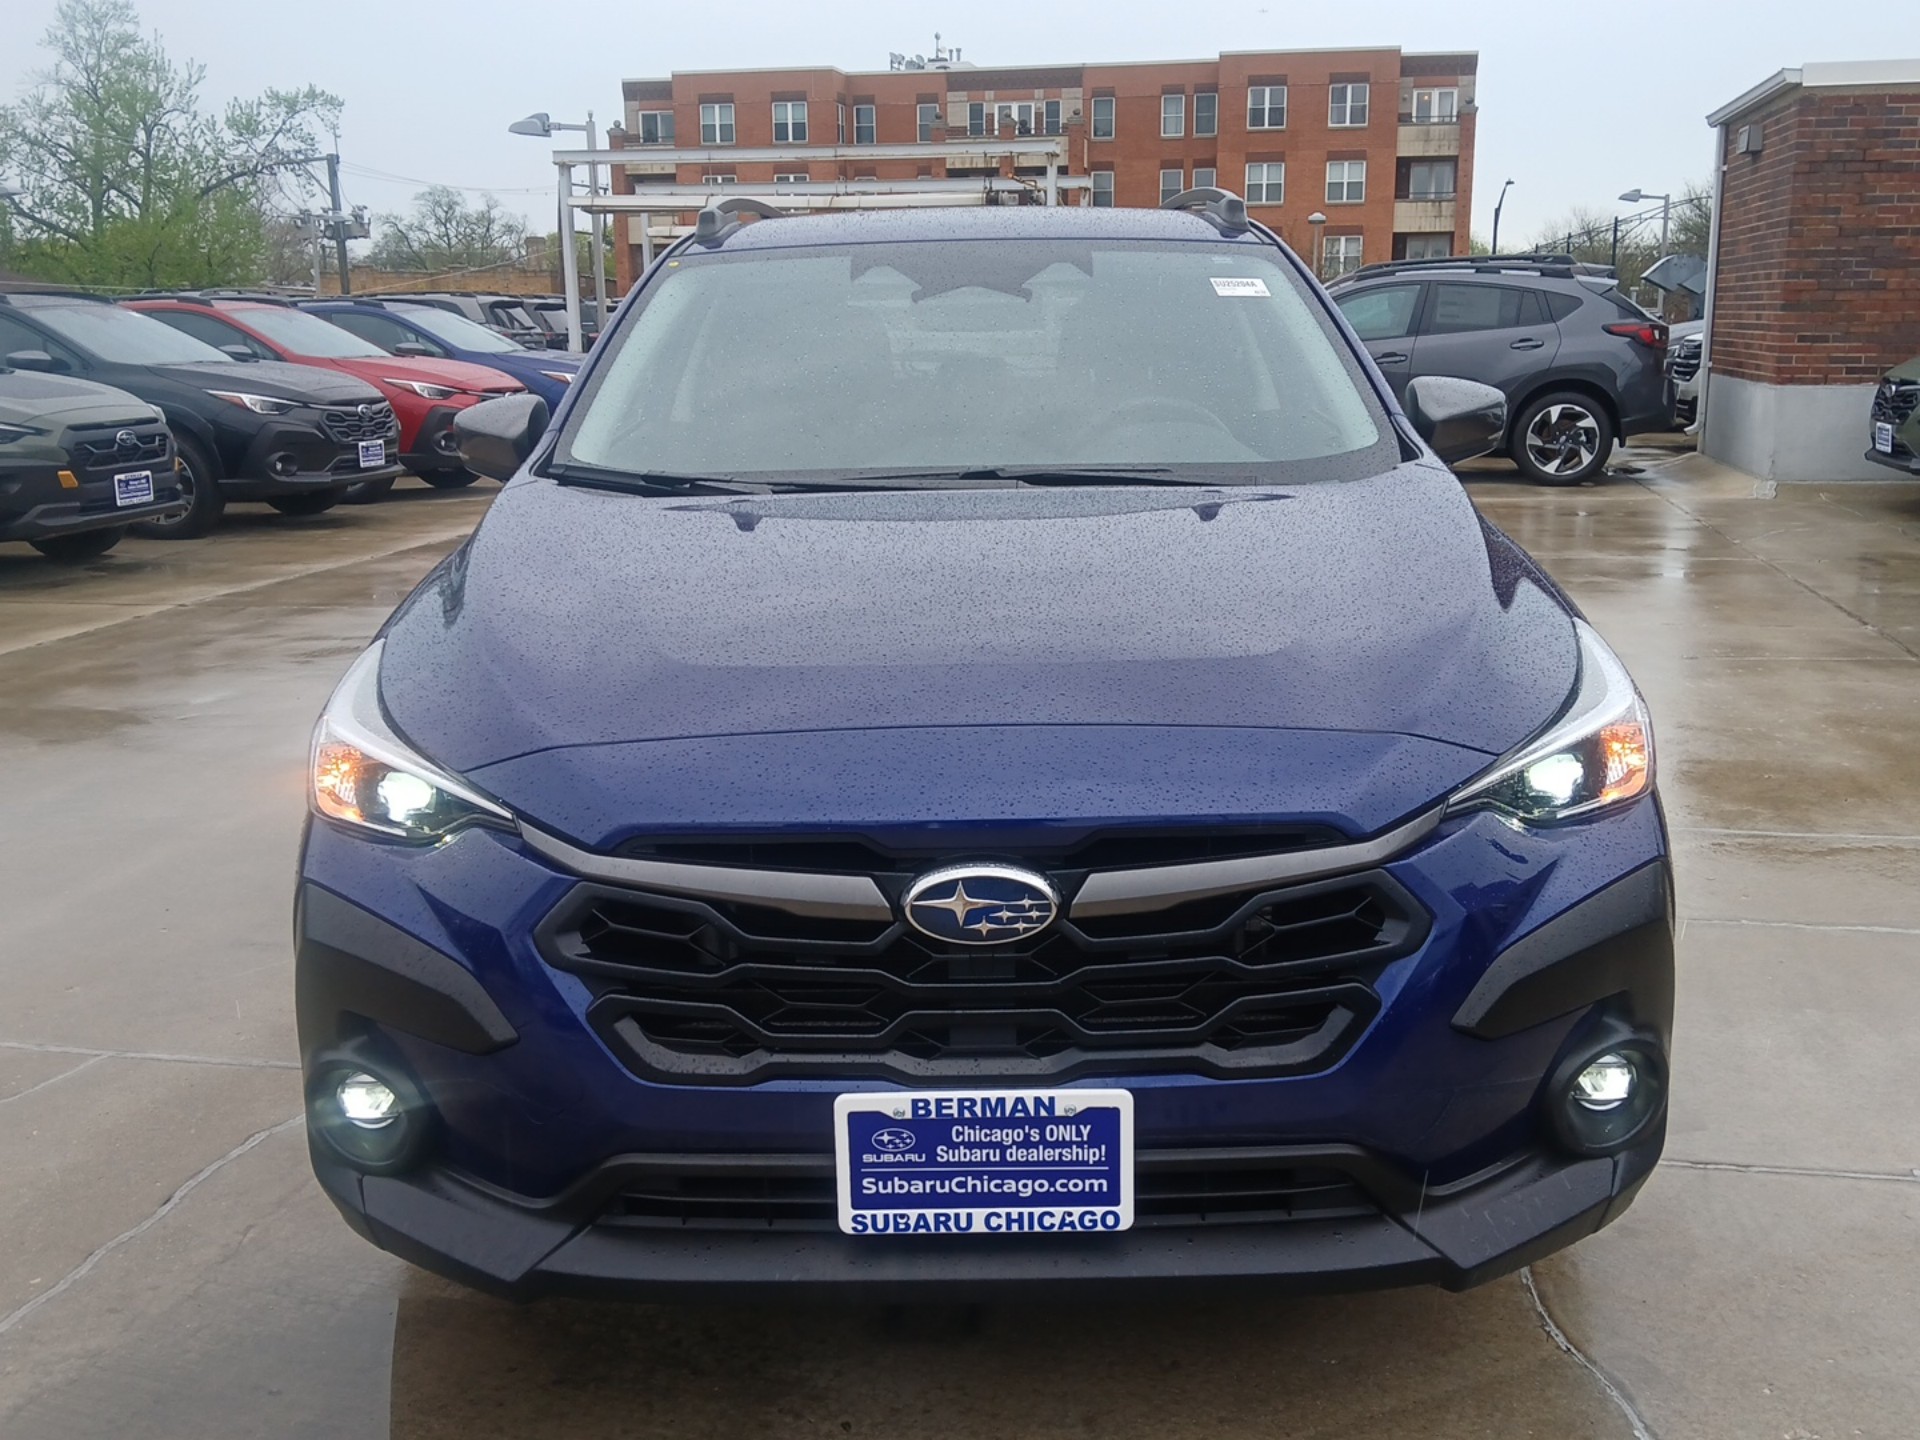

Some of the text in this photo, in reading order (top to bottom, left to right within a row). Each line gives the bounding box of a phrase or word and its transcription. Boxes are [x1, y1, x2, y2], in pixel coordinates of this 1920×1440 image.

[911, 1096, 1056, 1119] BERMAN
[951, 1124, 1091, 1145] Chicago's ONLY
[862, 1153, 926, 1163] SUBARU
[936, 1145, 1106, 1164] Subaru dealership!
[862, 1175, 1108, 1196] SubaruChicago.com
[851, 1210, 1121, 1233] SUBARU CHICAGO
